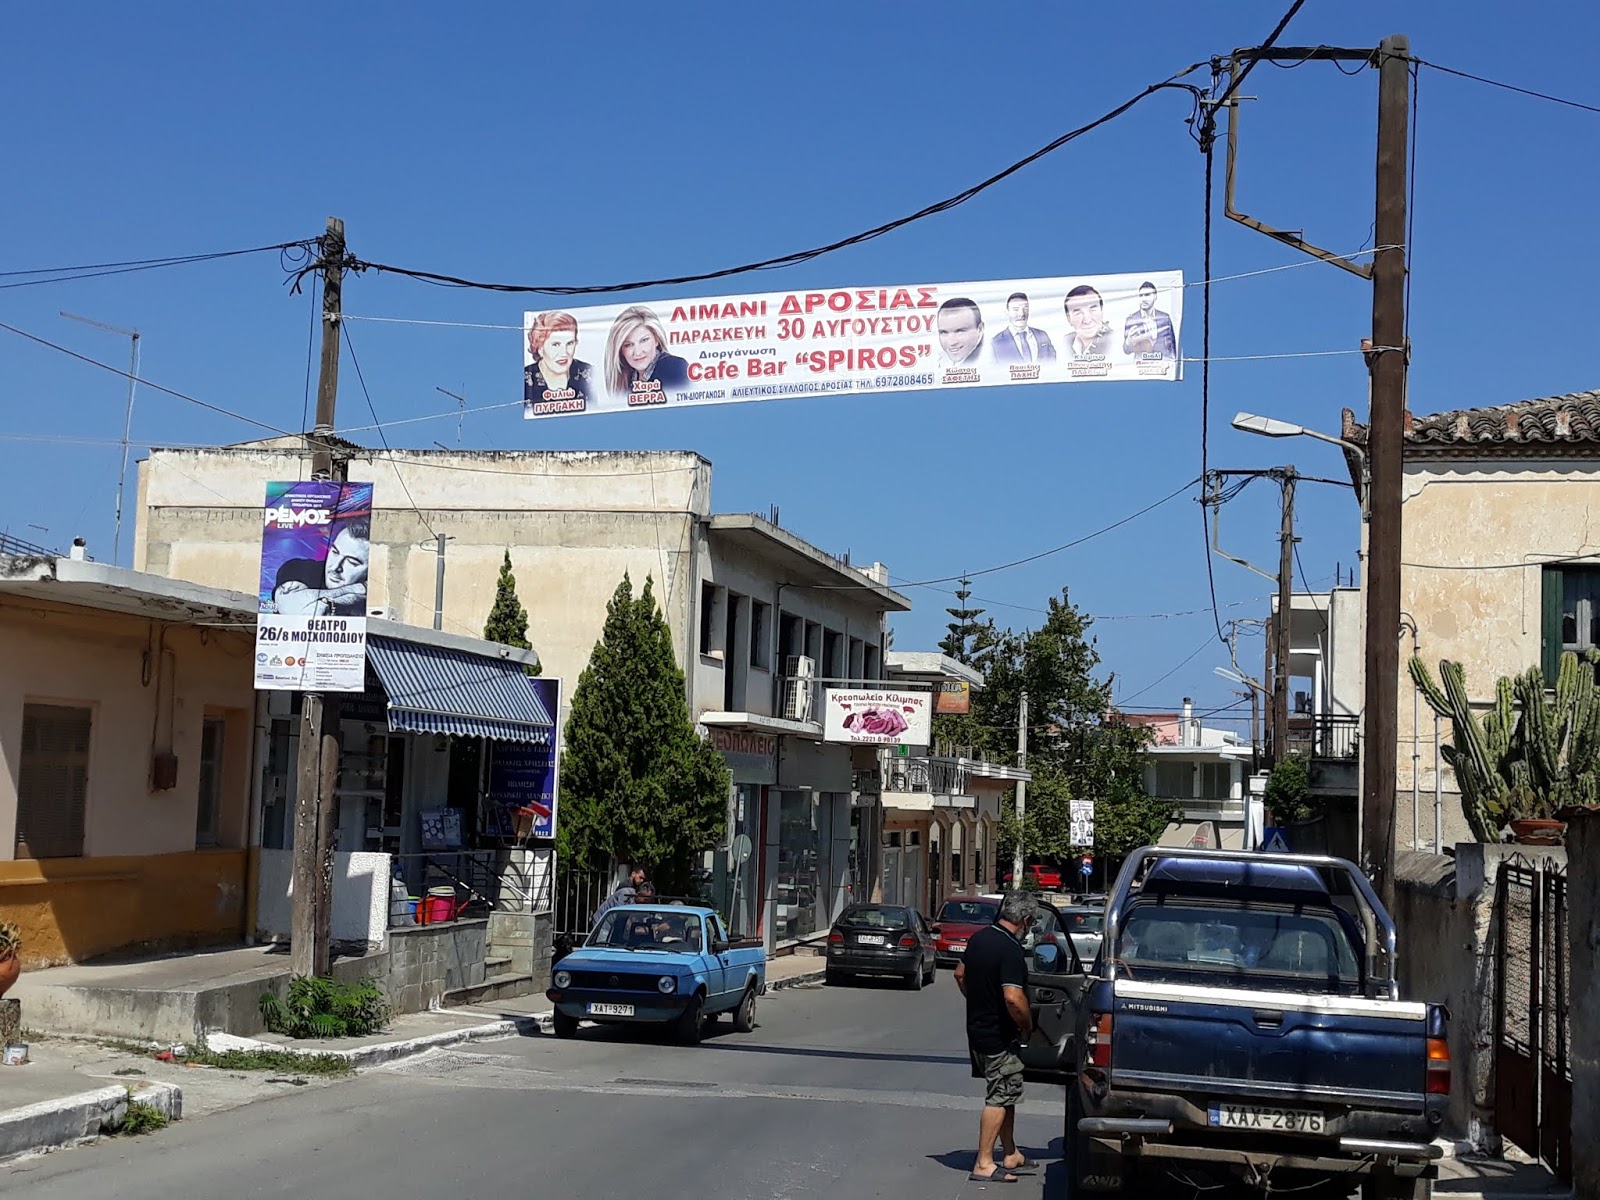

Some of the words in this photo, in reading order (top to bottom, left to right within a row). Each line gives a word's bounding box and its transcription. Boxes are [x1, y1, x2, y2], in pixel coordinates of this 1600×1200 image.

[671, 300, 767, 322] ΛΙΜΑΝΙ
[778, 287, 938, 315] ΔΡΟΣΙΑΣ
[669, 325, 766, 344] ΠΑΡΑΣΚΕΥΗ
[777, 317, 805, 340] 30
[812, 314, 936, 337] ΑΥΓΟΥΣΤΟΥ
[699, 347, 776, 360] Διοργάνωση
[688, 360, 739, 381] Cafe
[747, 358, 788, 377] Bar
[633, 380, 660, 391] Χαρά
[732, 385, 777, 397] ΑΛΙΕΥΤΙΚΟΣ
[779, 382, 819, 394] ΣΥΛΛΟΓΟΣ
[821, 381, 853, 391] ΔΡΟΣΙΑΣ
[875, 374, 933, 387] 6972808465
[543, 389, 575, 399] Φυλιώ
[629, 393, 665, 405] ΒΕΡΡΑ
[534, 401, 584, 414] ΠΥΡΓΑΚΗ
[307, 619, 347, 631] ΘΕΑΤΡΟ
[291, 631, 364, 643] ΜΟΣΧΟΠΟΔΙΟΥ
[831, 693, 883, 703] Κρεοπωλείο
[886, 693, 924, 707] Κίλιμπας
[1128, 1003, 1168, 1012] MITSUBISHI
